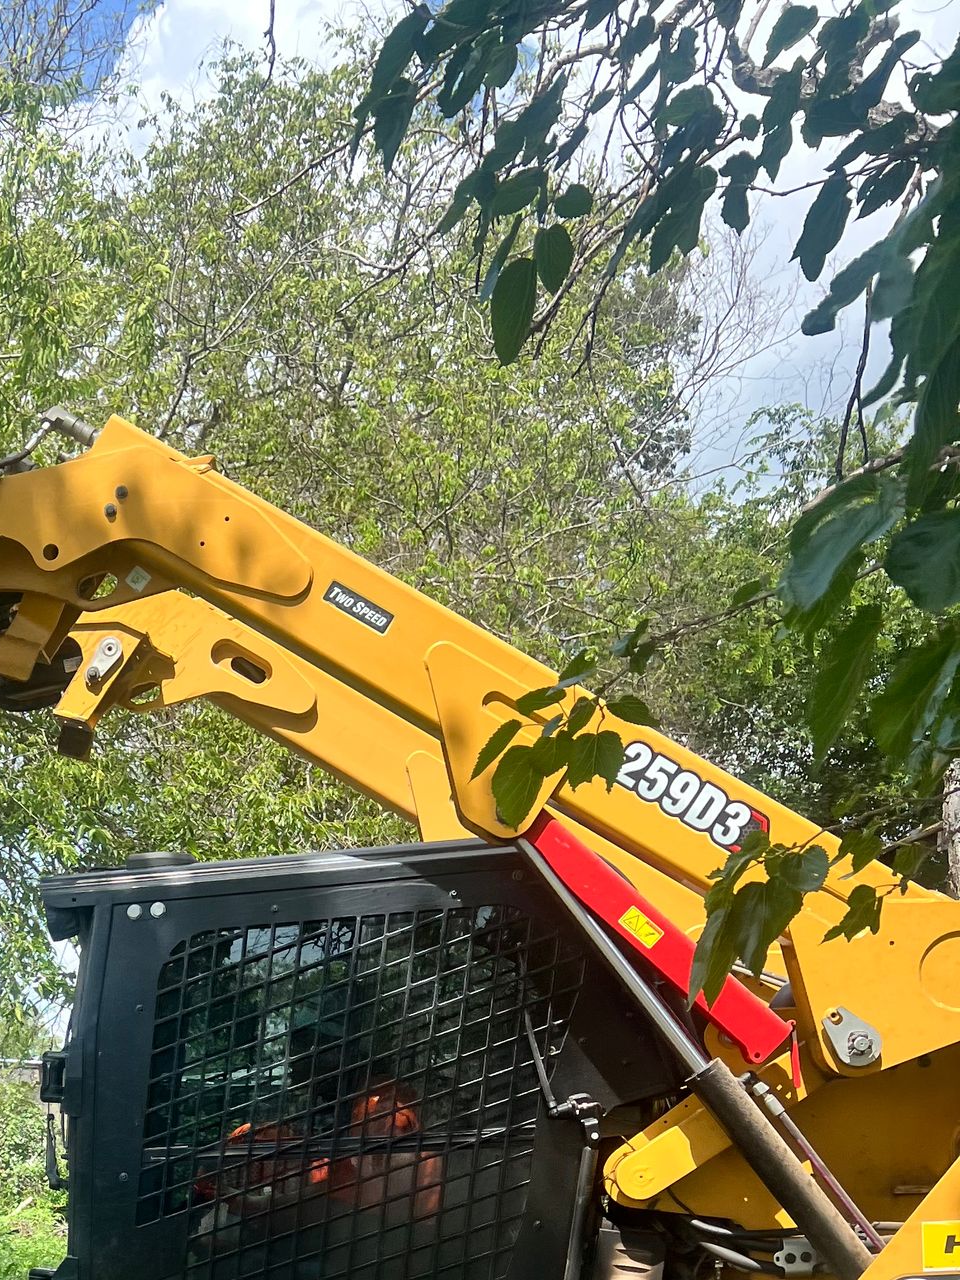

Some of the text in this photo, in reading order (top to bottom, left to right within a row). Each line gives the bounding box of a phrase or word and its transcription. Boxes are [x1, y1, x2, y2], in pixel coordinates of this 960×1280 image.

[329, 586, 388, 627] TWO SPEED
[616, 740, 752, 846] 259D3
